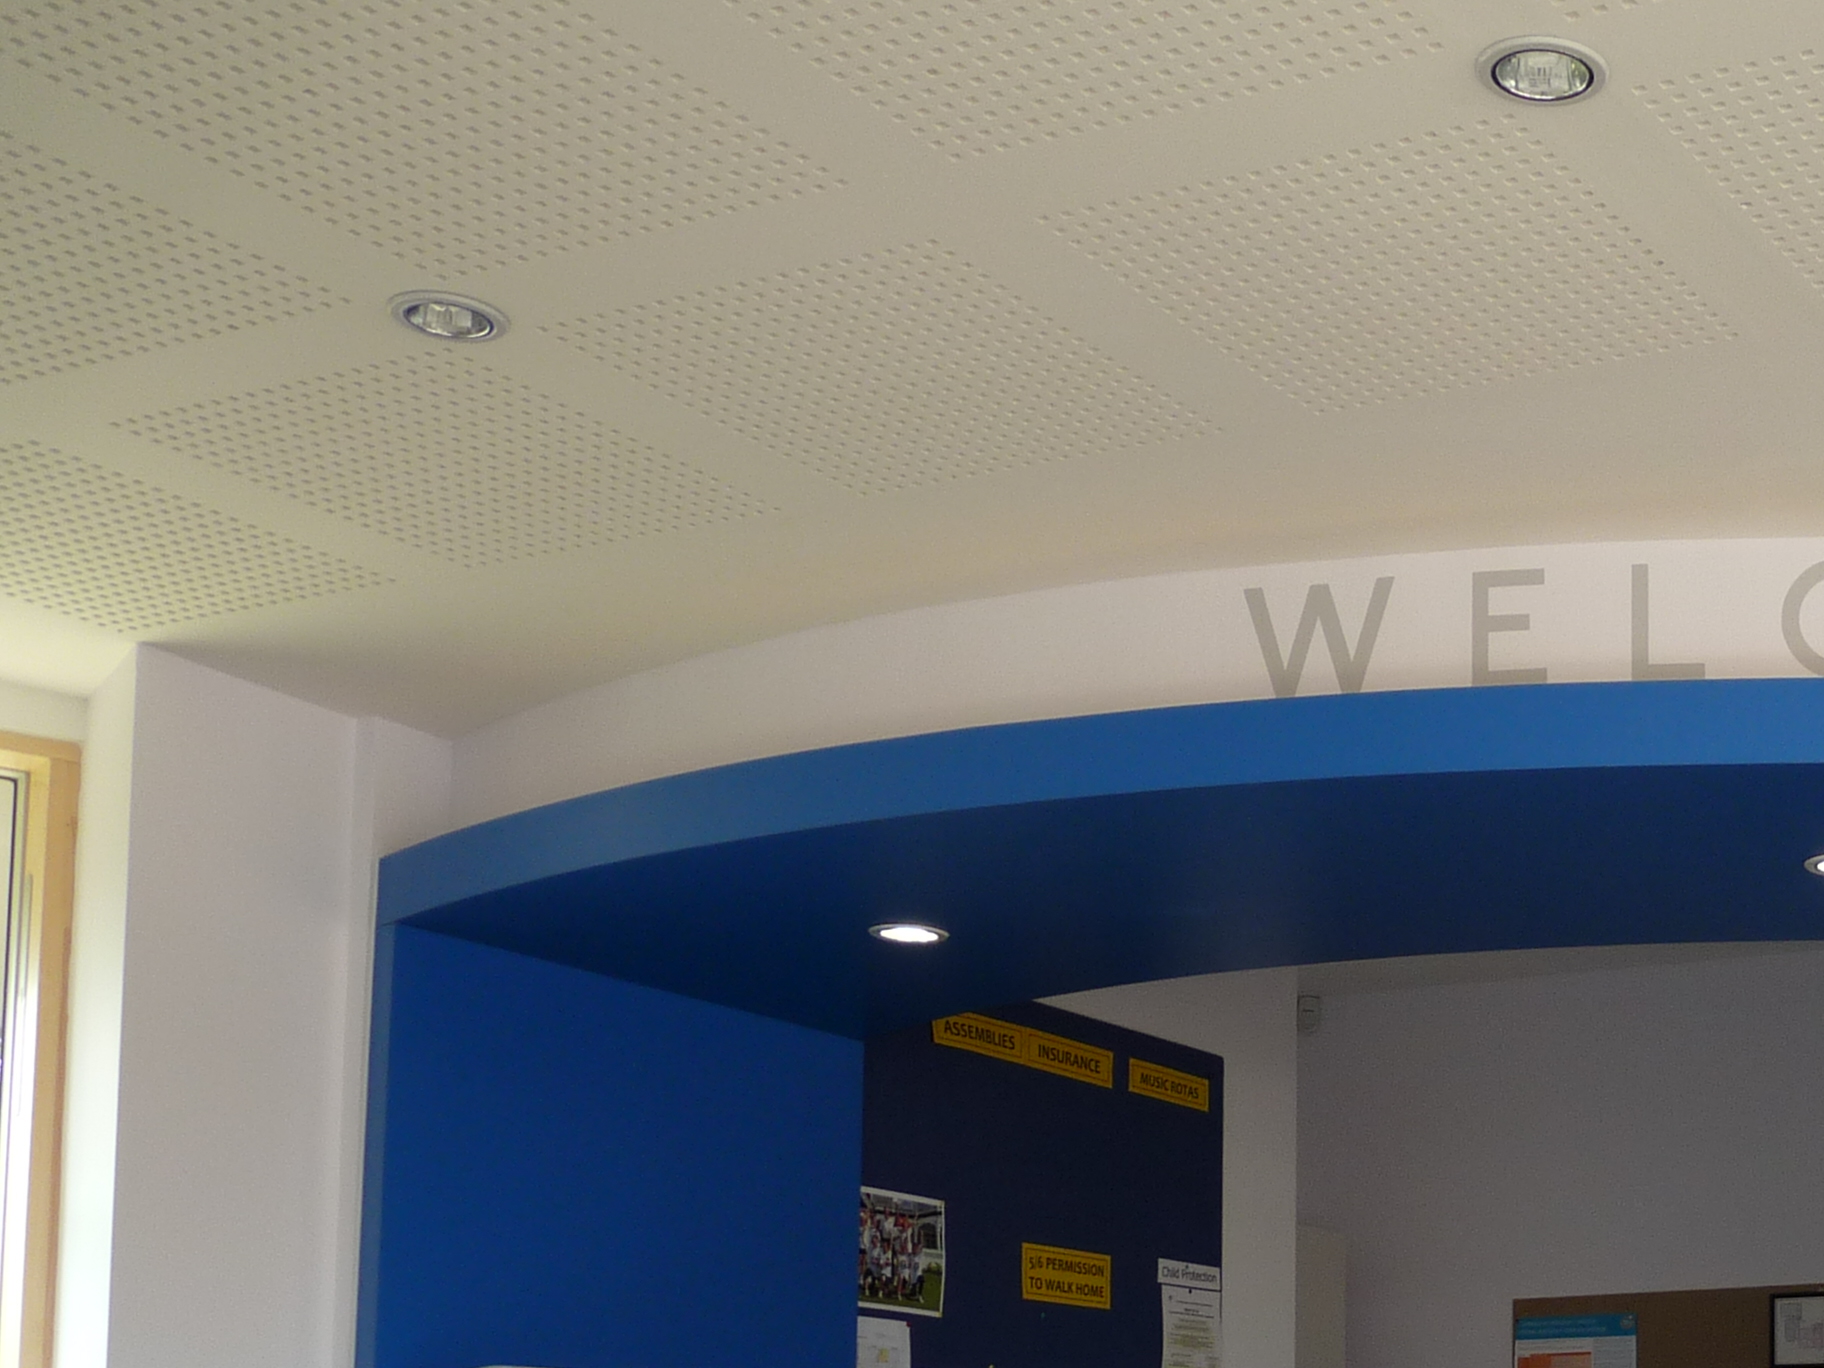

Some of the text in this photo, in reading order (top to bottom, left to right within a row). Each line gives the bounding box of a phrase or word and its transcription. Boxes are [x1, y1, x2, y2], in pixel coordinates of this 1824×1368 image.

[944, 1019, 1016, 1050] ASSEMBLIES
[1037, 1044, 1101, 1074] INSURANCE
[1139, 1072, 1200, 1100] MUSIC ROTAS
[1028, 1256, 1105, 1278] 5/6 PERMISSION
[1161, 1266, 1218, 1284] Child Protection
[1028, 1277, 1105, 1298] TO WALK HOME
